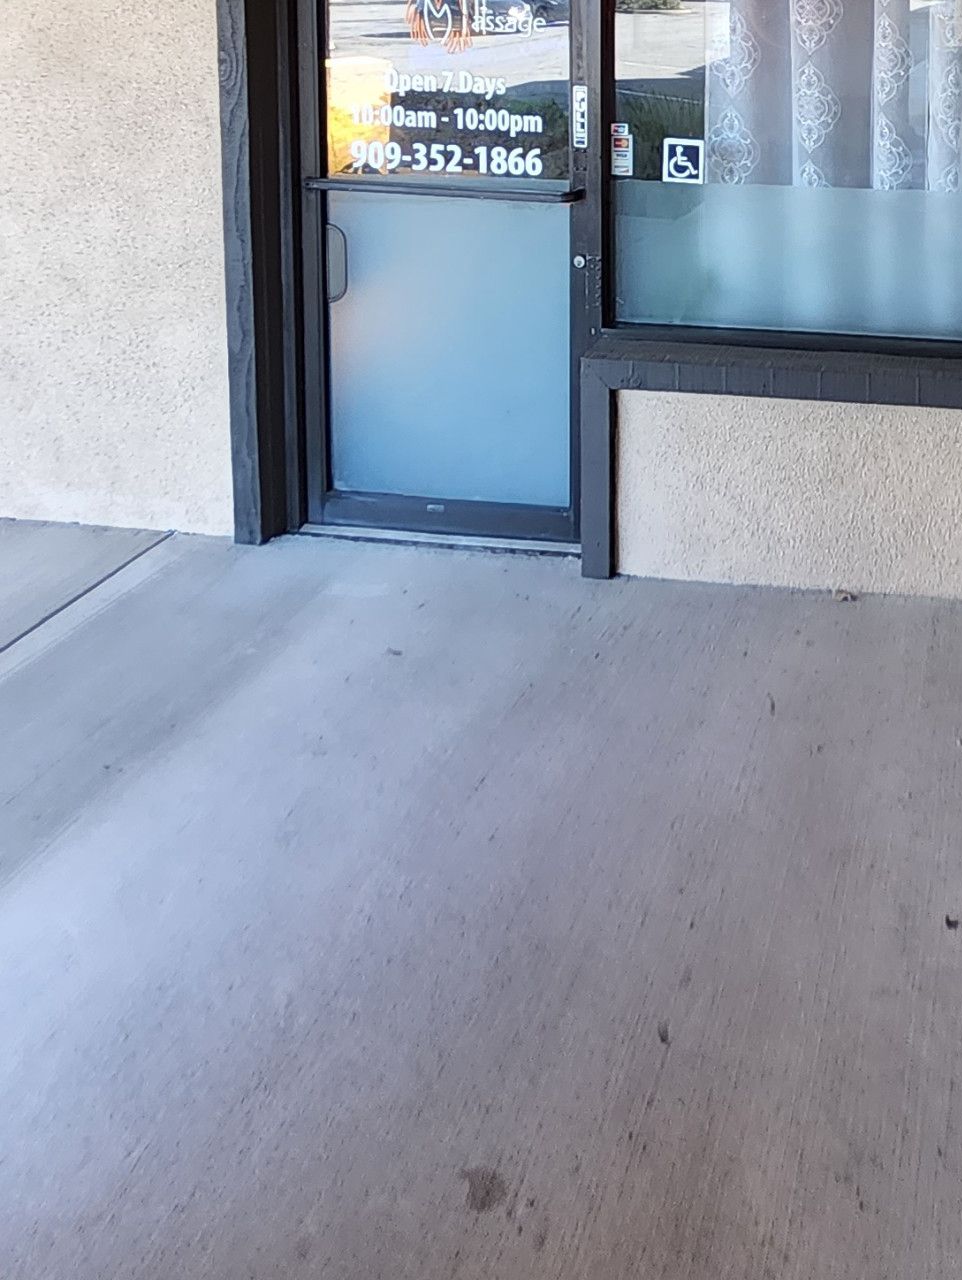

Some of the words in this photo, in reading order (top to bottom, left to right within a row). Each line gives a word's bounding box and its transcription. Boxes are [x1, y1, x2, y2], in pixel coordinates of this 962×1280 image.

[385, 68, 438, 97] Open
[441, 71, 454, 93] 7
[458, 71, 507, 100] Days
[351, 104, 437, 129] 10:00am
[453, 107, 543, 137] 10:00pm
[350, 140, 543, 176] 909-352-1866
